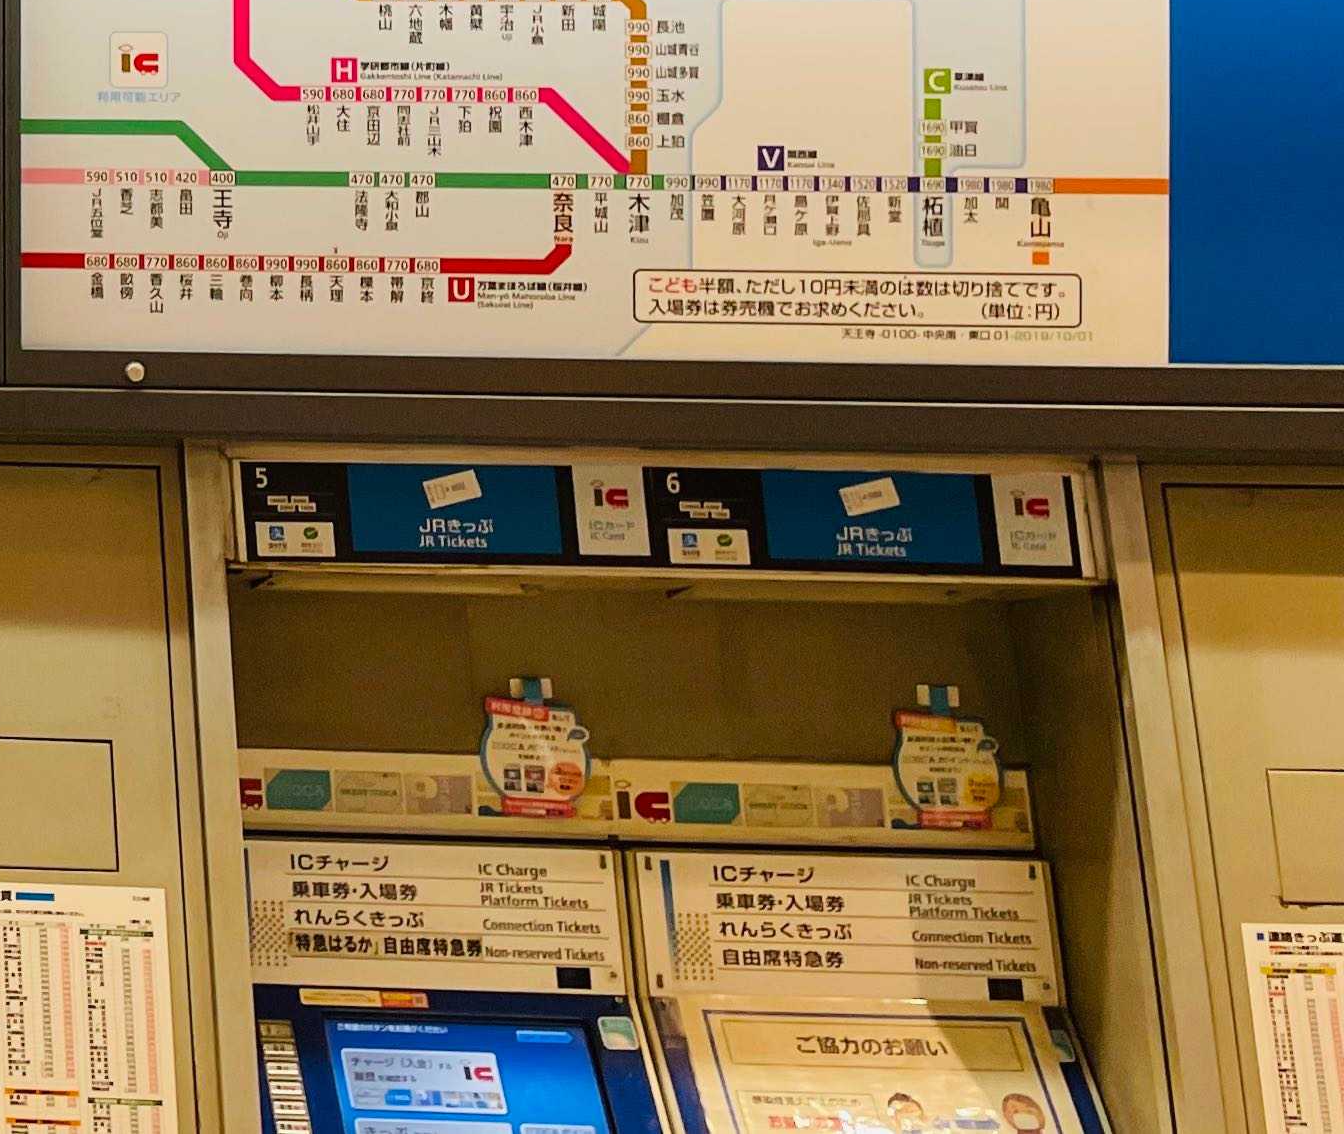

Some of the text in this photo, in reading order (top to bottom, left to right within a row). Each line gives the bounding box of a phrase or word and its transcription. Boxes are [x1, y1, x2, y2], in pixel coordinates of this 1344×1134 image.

[212, 189, 234, 230] 王寺
[553, 192, 574, 233] 奈良
[628, 194, 650, 233] 木津
[1030, 198, 1051, 238] 亀山
[255, 468, 268, 488] 5
[666, 473, 680, 494] 6
[419, 518, 494, 534] JRきっぷ
[419, 535, 488, 549] JR Tickets
[837, 544, 906, 558] JR Tickets
[290, 854, 389, 871] ICチャージ
[713, 865, 815, 883] ICチャージ
[292, 881, 417, 901] 乗車券・入場券
[716, 892, 845, 912] 乗車券・入場券
[295, 909, 425, 928] れんらくきっぷ
[720, 921, 853, 940] れんらくきっぷ
[722, 948, 845, 968] 自由席特急券
[796, 1035, 949, 1057] ご協力のお願い
